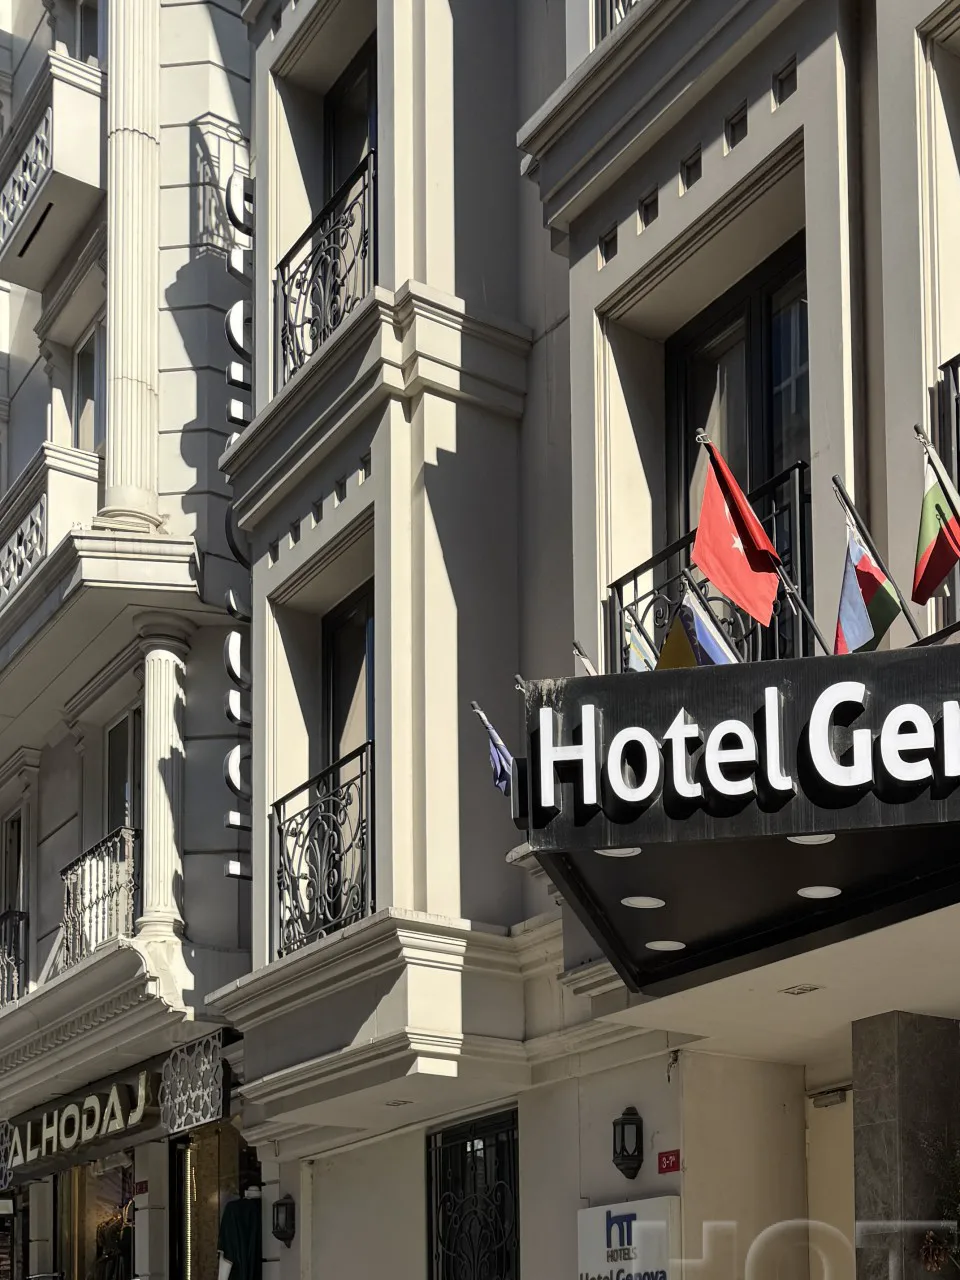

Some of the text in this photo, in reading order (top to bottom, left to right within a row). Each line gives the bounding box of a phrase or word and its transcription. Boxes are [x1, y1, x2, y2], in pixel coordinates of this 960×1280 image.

[539, 687, 796, 809] Hotel
[8, 1070, 148, 1169] ALHODAJ
[606, 1247, 637, 1263] HOTELS
